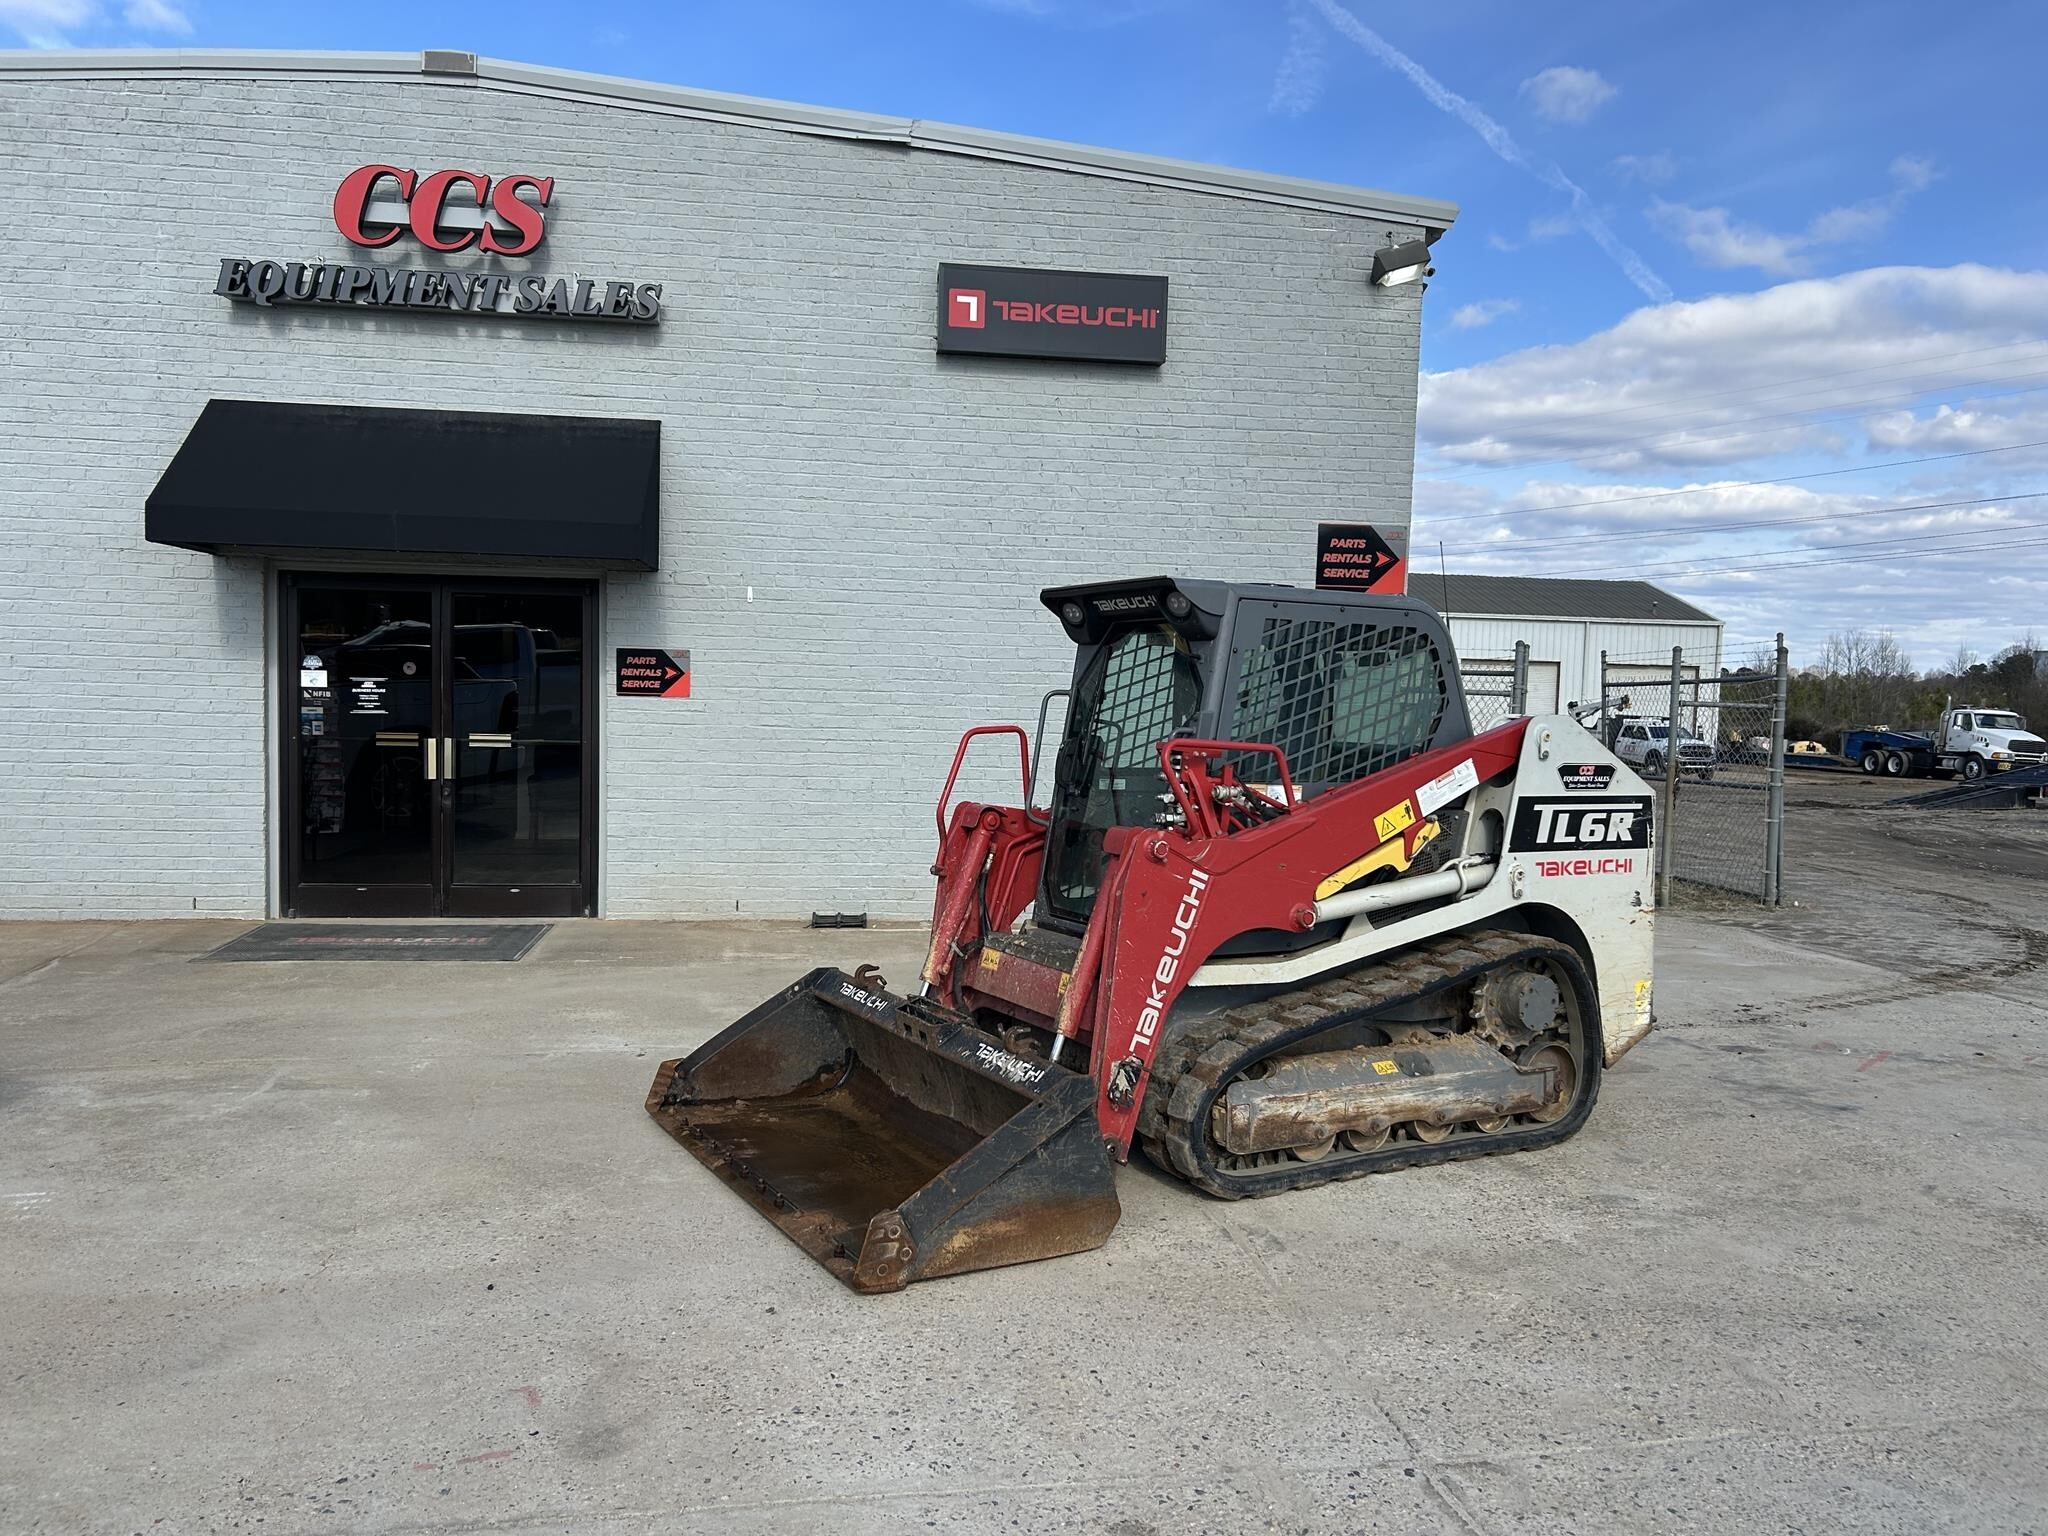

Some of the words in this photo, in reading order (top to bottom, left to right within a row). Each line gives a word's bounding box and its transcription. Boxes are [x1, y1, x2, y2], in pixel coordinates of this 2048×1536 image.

[333, 164, 554, 258] CCS
[214, 257, 510, 311] EQUIPMENT
[513, 276, 663, 322] SALES
[1329, 538, 1367, 549] PARTS
[1322, 553, 1372, 564] RENTALS
[1323, 568, 1370, 578] SERVICE
[626, 656, 657, 665] PARTS
[620, 668, 662, 677] RENTALS
[621, 680, 661, 688] SERVICE
[1563, 775, 1594, 783] EQUIPMENT
[1534, 803, 1643, 844] TL6R
